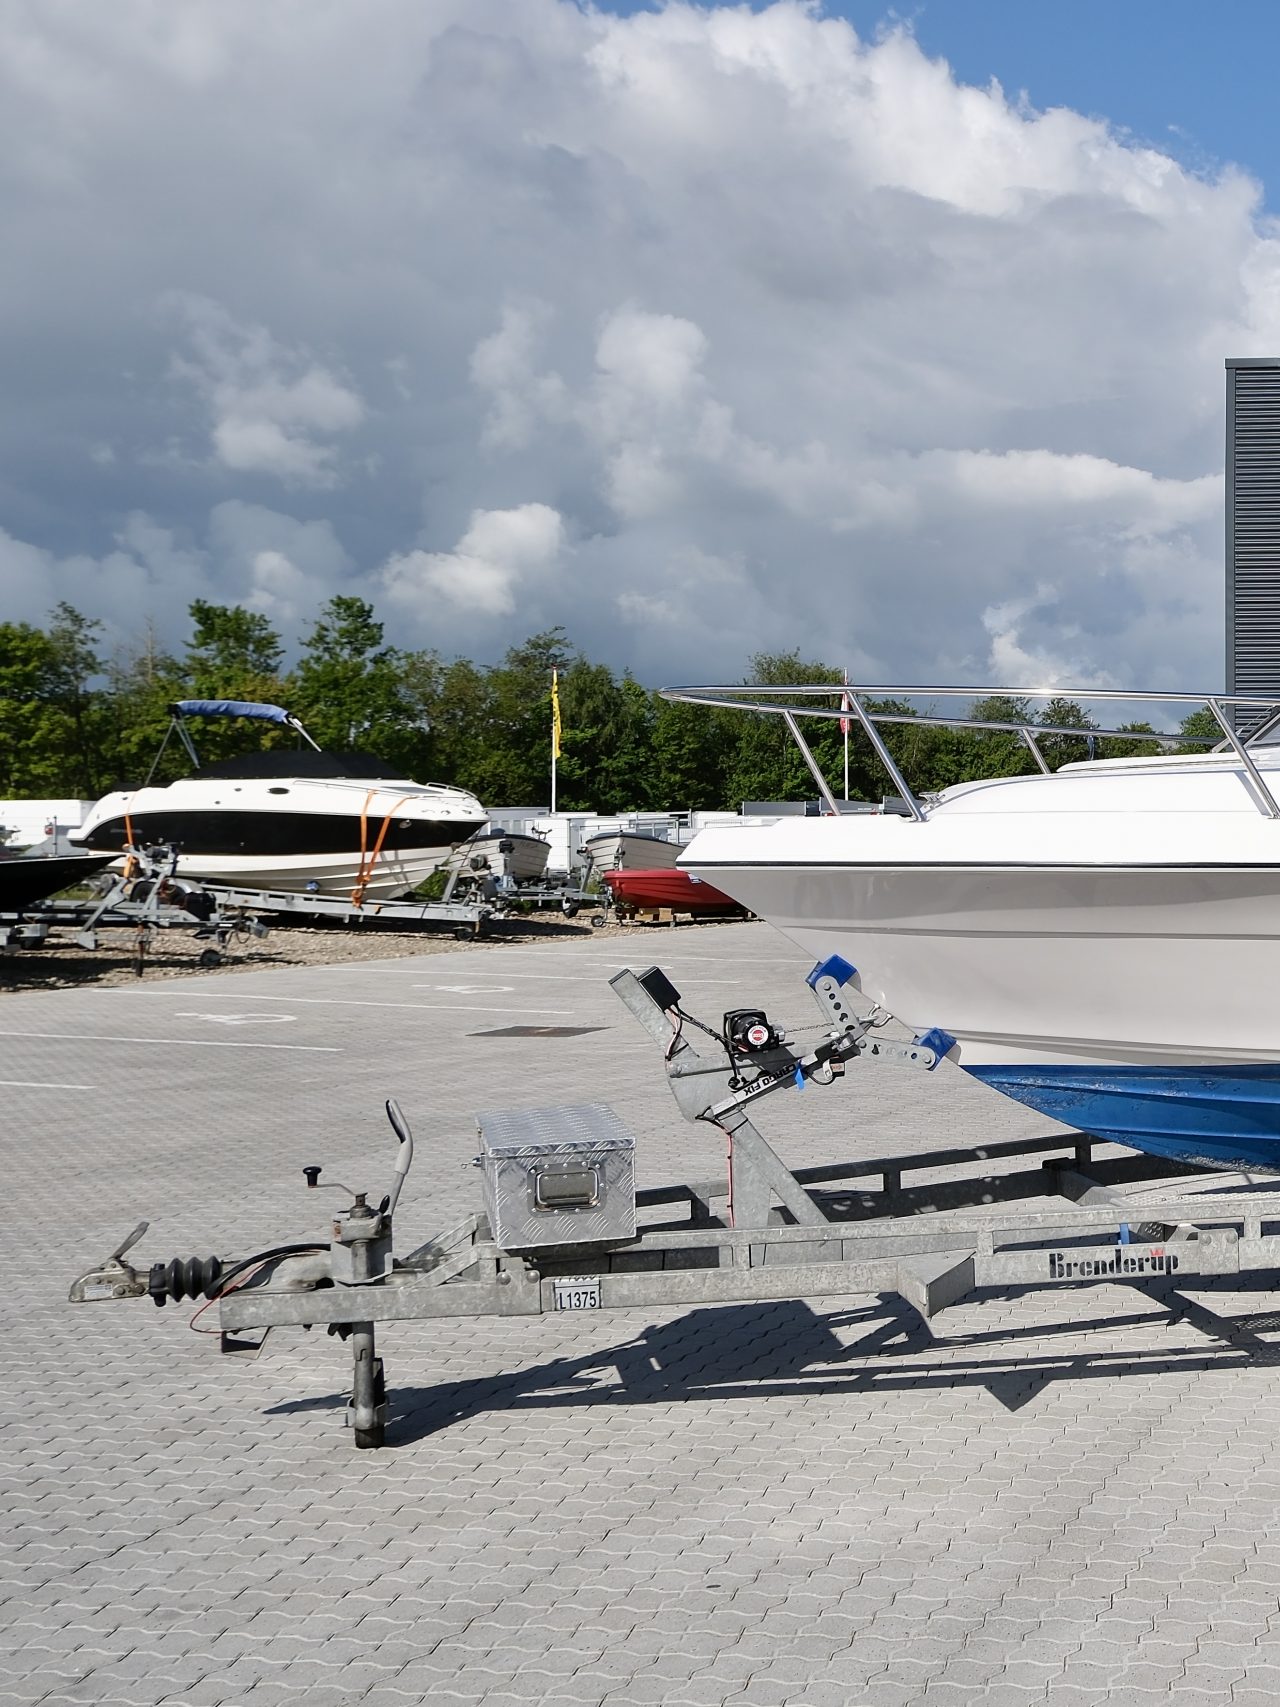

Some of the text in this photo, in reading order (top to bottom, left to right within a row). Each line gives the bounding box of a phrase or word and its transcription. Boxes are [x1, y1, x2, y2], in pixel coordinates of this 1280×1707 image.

[743, 1063, 797, 1097] CARGO FIX
[1049, 1249, 1179, 1278] Brenderup
[560, 1291, 597, 1309] L1375
